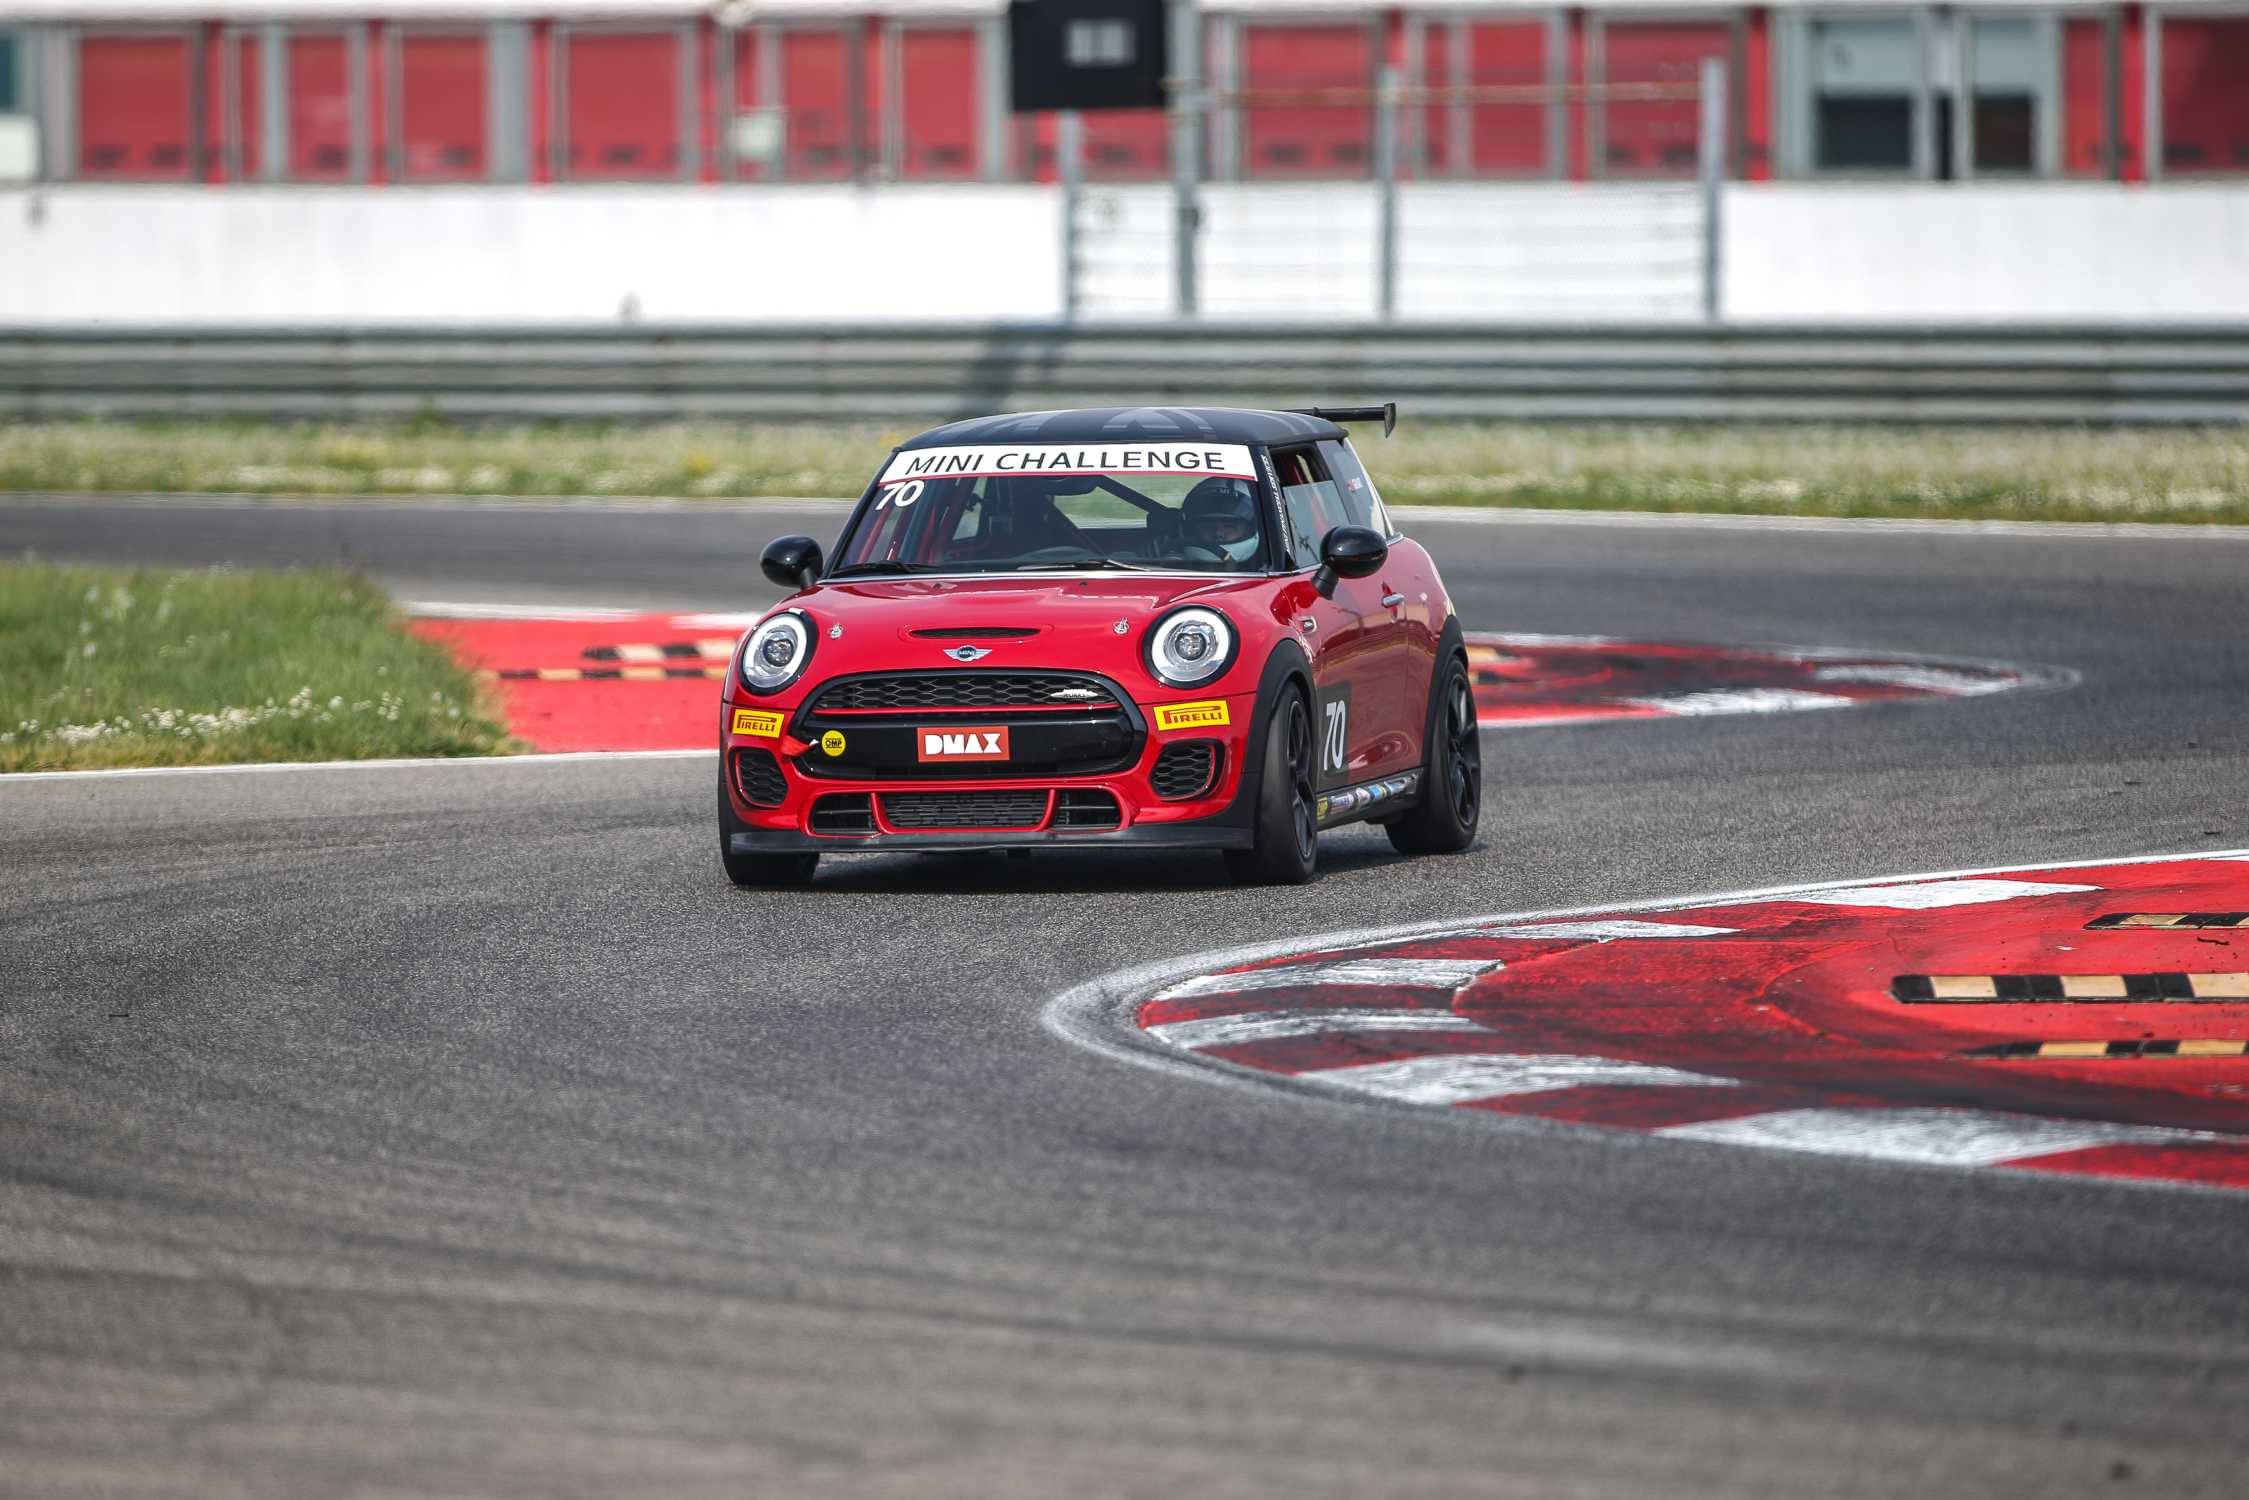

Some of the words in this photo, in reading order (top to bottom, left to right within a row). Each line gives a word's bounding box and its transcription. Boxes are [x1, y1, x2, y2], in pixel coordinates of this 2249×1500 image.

[905, 454, 984, 475] MINI
[996, 451, 1225, 470] CHALLENGE
[875, 480, 925, 511] 70
[737, 714, 777, 732] PIRELLI
[1163, 706, 1222, 724] PIRELLI
[825, 739, 842, 749] OMP
[925, 733, 1002, 755] DMAX
[1323, 700, 1346, 771] 70
